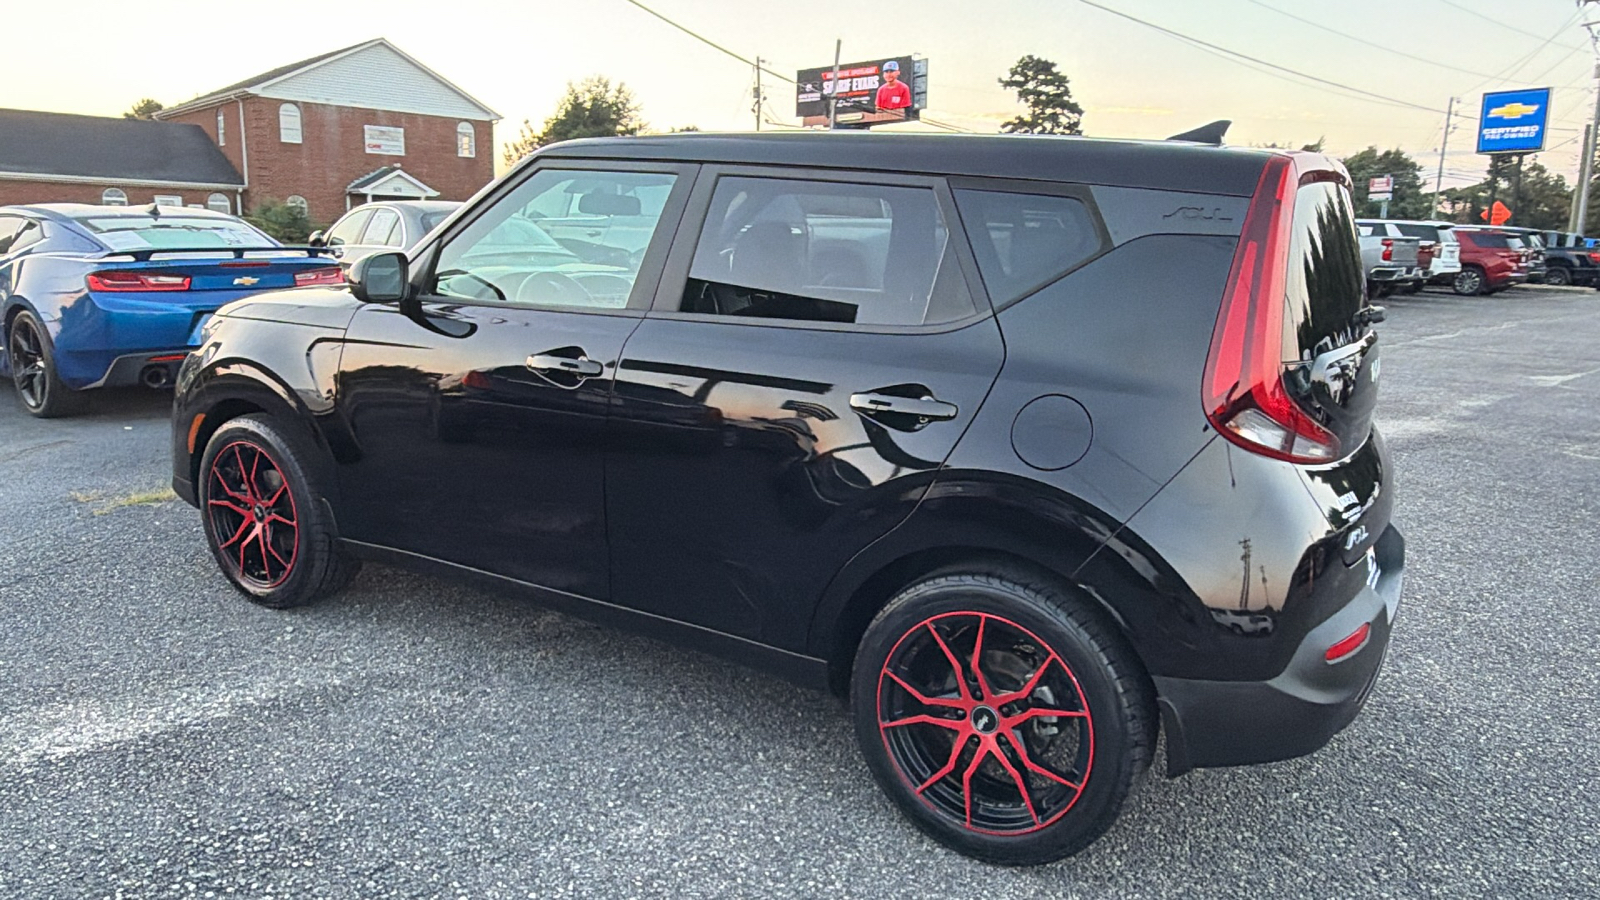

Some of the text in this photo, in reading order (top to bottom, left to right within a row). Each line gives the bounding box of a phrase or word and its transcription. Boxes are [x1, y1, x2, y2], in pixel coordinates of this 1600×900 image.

[852, 76, 880, 91] EVANS
[1482, 125, 1540, 135] CERTIFIED
[1484, 131, 1536, 140] PRE-OWNED
